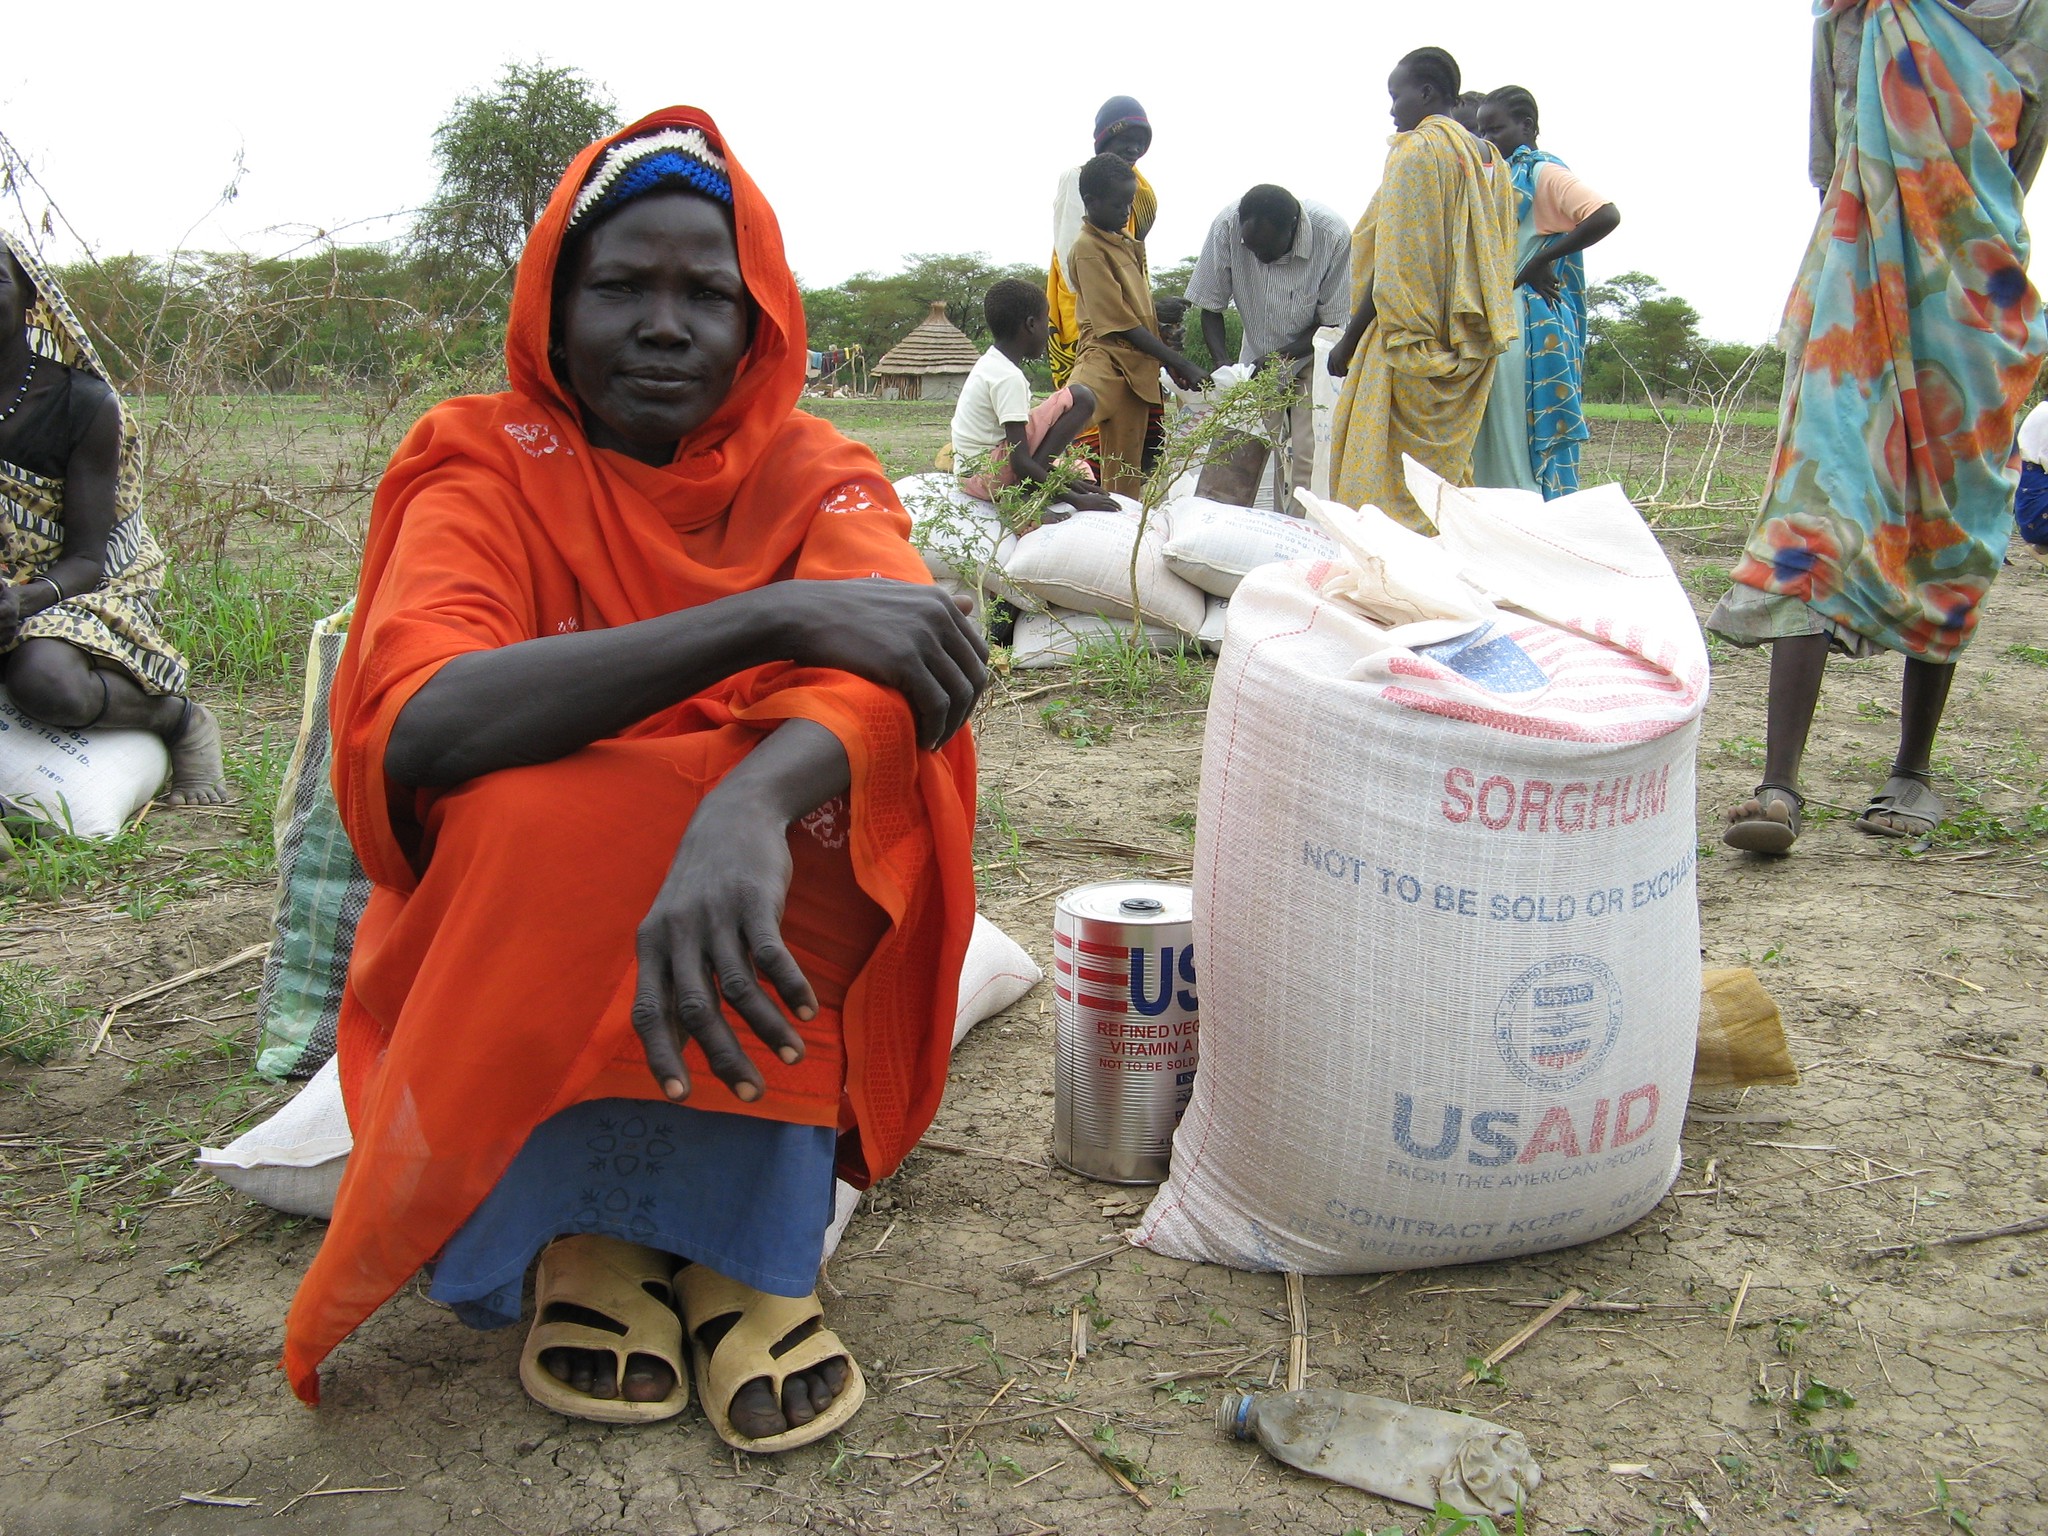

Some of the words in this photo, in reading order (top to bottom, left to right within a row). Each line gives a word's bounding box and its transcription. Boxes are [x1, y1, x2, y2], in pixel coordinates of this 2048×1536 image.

[0, 703, 16, 716] 50
[37, 727, 77, 755] 110.23
[76, 754, 90, 768] lb.
[1441, 762, 1670, 834] SORGHUM
[1303, 840, 1367, 885] NOT
[1376, 866, 1422, 903] TO
[1434, 884, 1478, 917] BE
[1490, 893, 1576, 922] SOLD
[1586, 887, 1624, 917] OR
[1097, 1021, 1170, 1039] REFINED
[1110, 1041, 1178, 1056] VITAMIN
[1182, 1038, 1193, 1053] A
[1099, 1058, 1123, 1070] NOT
[1126, 1060, 1142, 1071] TO
[1146, 1061, 1163, 1071] BE
[1166, 1056, 1196, 1071] SOLD
[1391, 1083, 1661, 1167] USAID
[1386, 1159, 1447, 1185] FROM
[1455, 1172, 1495, 1189] THE
[1498, 1160, 1600, 1188] AMERICAN
[1602, 1137, 1656, 1168] PEOPLE
[1325, 1199, 1500, 1239] CONTRACT
